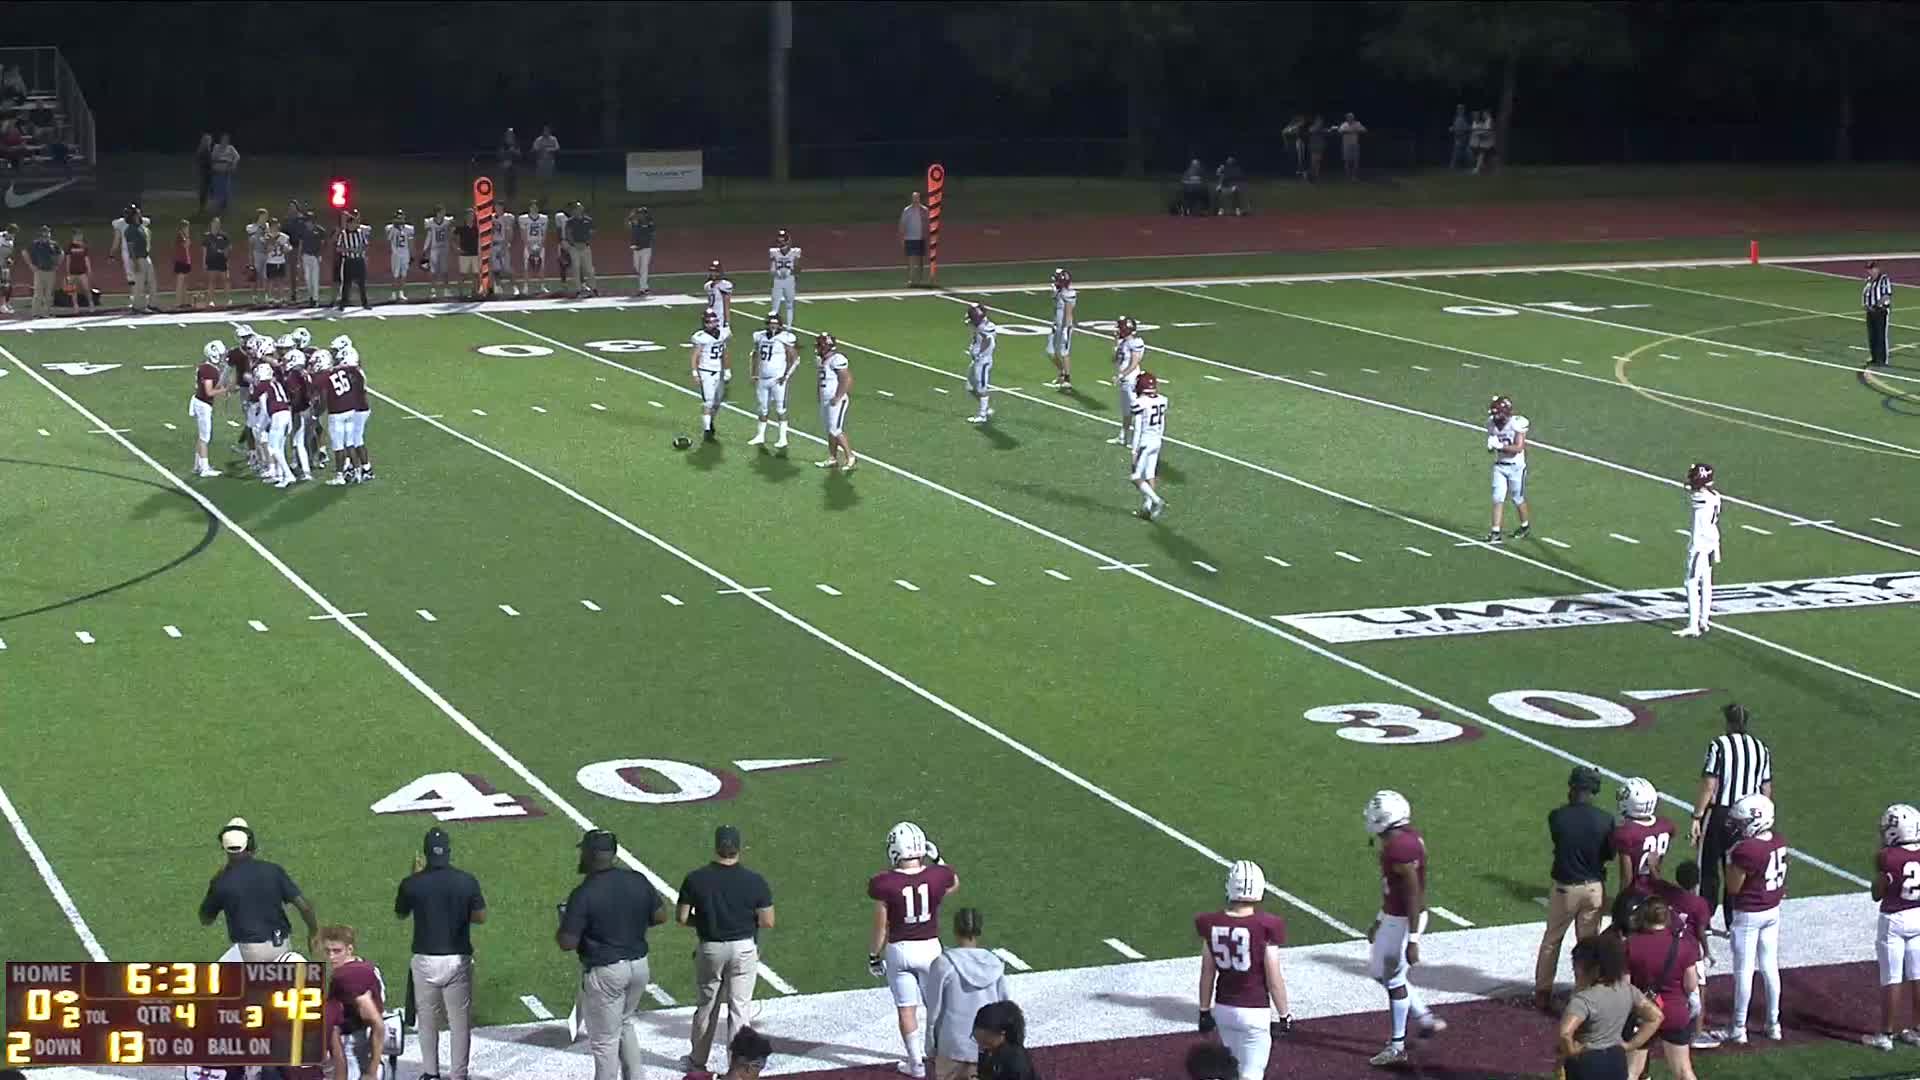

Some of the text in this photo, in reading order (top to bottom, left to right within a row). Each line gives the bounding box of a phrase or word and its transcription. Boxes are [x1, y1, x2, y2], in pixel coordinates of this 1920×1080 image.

[1764, 847, 1788, 891] 45
[901, 882, 931, 924] 11
[1210, 926, 1252, 972] 53
